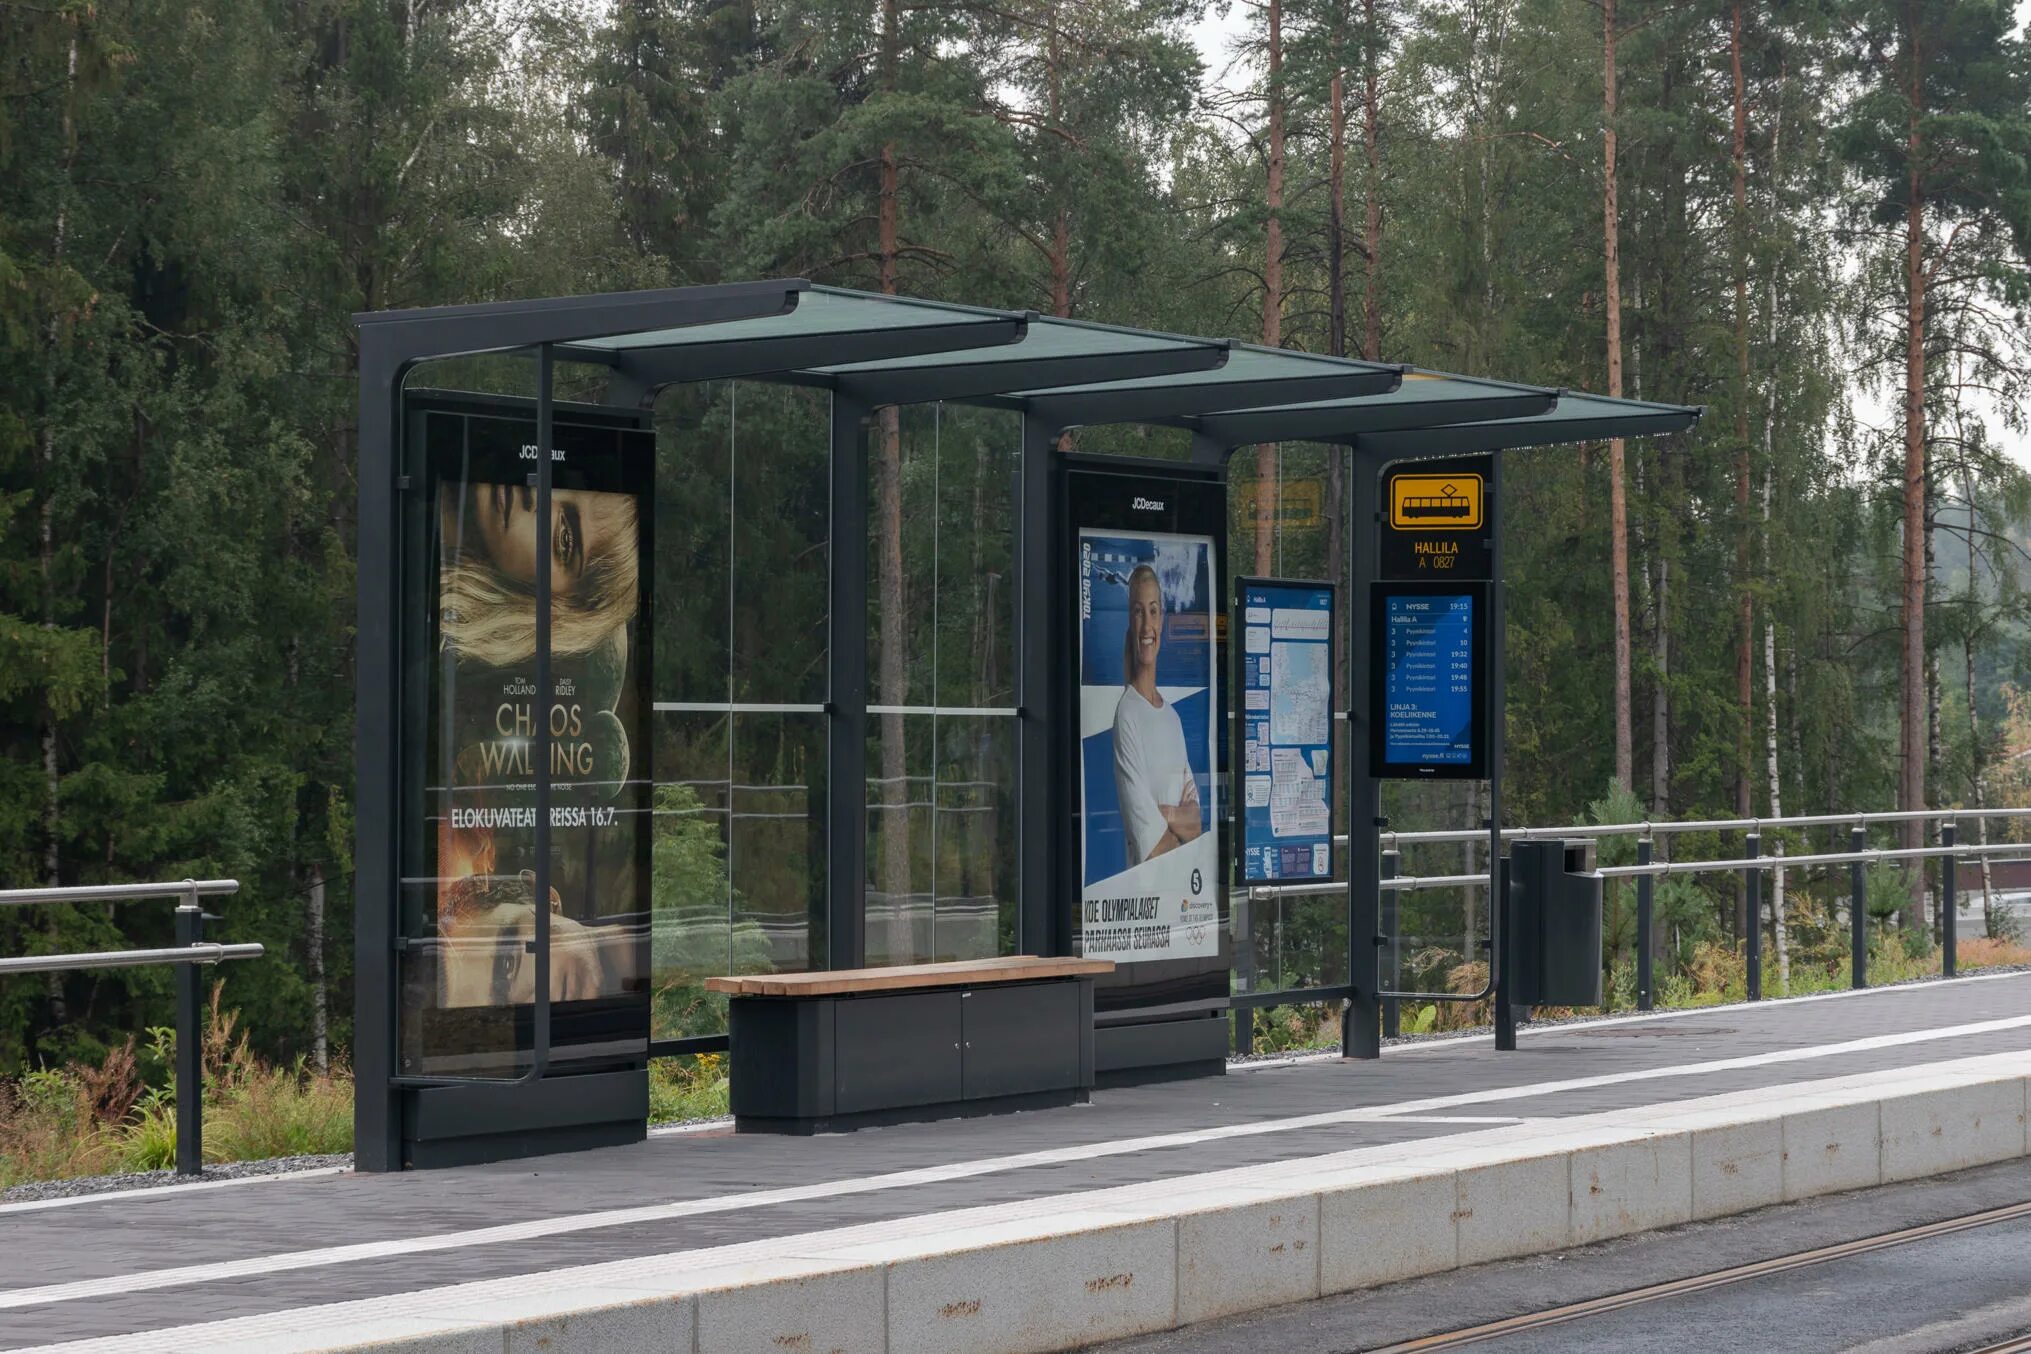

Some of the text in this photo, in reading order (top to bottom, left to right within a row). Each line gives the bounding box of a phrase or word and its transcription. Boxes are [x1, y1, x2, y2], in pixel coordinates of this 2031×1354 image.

[519, 445, 565, 461] JCDaux
[1132, 497, 1164, 511] JCDecaux
[1415, 542, 1458, 554] HALLILA
[1419, 556, 1455, 568] A 0827
[1082, 543, 1091, 619] TOKYO 2020
[503, 684, 536, 695] HOLLAND
[555, 685, 576, 696] RIDLEY
[495, 703, 582, 736] CHOS
[479, 742, 593, 775] WALING
[452, 806, 618, 828] ELOKUVATEATREISSA 16.7.
[1101, 896, 1160, 922] OLYMPIALAISET
[1084, 925, 1170, 953] PARHAASSA SEURASSA
